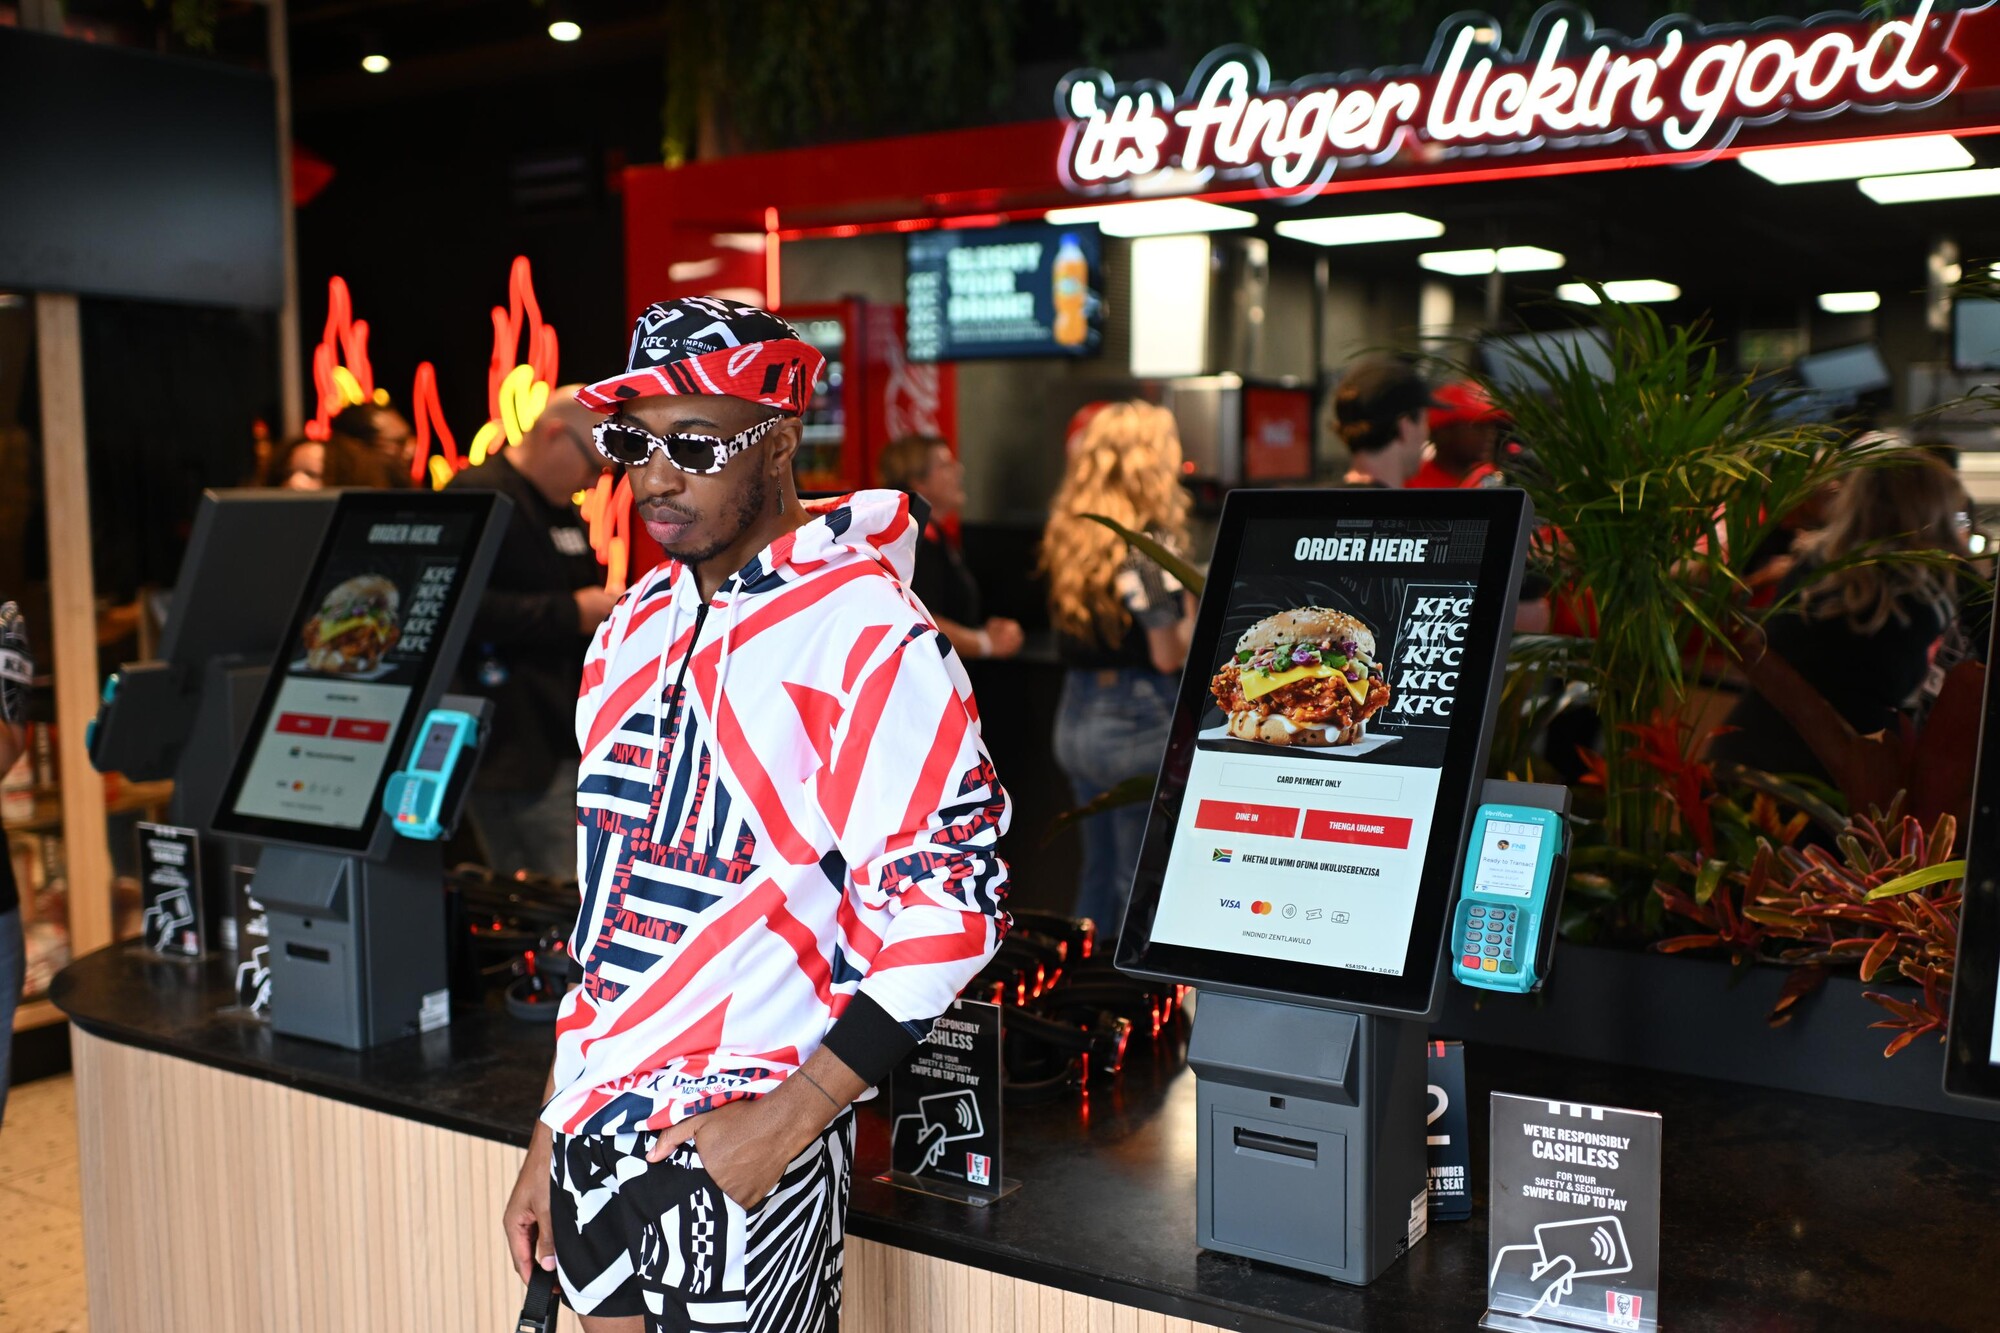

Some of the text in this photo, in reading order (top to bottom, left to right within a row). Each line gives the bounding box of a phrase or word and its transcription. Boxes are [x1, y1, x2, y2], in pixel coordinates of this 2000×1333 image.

[1175, 61, 1421, 188] finger
[1427, 18, 1682, 140] lickin'
[1663, 0, 1939, 149] good
[640, 336, 718, 352] KFC X IMPRINT
[1294, 537, 1429, 563] ORDER HERE
[423, 566, 456, 581] KFC
[416, 584, 450, 598] KFC
[410, 601, 444, 616] KFC
[1411, 597, 1474, 617] KFC
[403, 618, 437, 633] KFC
[1406, 621, 1469, 641] KFC
[397, 635, 431, 651] KFC
[1401, 645, 1464, 666] KFC
[1396, 670, 1459, 691] KFC
[1391, 694, 1455, 716] KFC
[1276, 775, 1342, 788] CARD PAYMENT ONLY
[1235, 812, 1259, 822] DINE IN
[1485, 810, 1513, 818] Verifone
[1329, 821, 1385, 834] THENGA UHAMBE
[1241, 854, 1380, 877] KHETHA ULWIMI OFUNA UKULUSEBENZISA
[1483, 856, 1501, 865] Ready
[1510, 859, 1534, 867] Transact
[1220, 898, 1241, 909] VISA
[1268, 933, 1312, 945] ZENTLAWULO
[935, 1018, 980, 1034] ESPONSIBLY
[943, 1054, 959, 1064] YOUR
[910, 1063, 932, 1077] SWIPE
[942, 1070, 956, 1081] TAP
[956, 1072, 966, 1084] TO
[966, 1074, 980, 1086] PAY
[944, 1062, 971, 1074] SECURITY
[1523, 1123, 1630, 1150] WE'RE RESPONSIBLY
[1532, 1139, 1619, 1170] CASHLESS
[1430, 1166, 1464, 1177] NUMBER
[1556, 1171, 1596, 1185] FOR YOUR
[1435, 1178, 1441, 1190] A
[1442, 1177, 1464, 1190] SEAT
[1534, 1176, 1616, 1197] SAFETY & SECURITY
[1522, 1184, 1628, 1212] SWIPE OR TAP TO PAY
[1613, 1317, 1634, 1328] KFC
